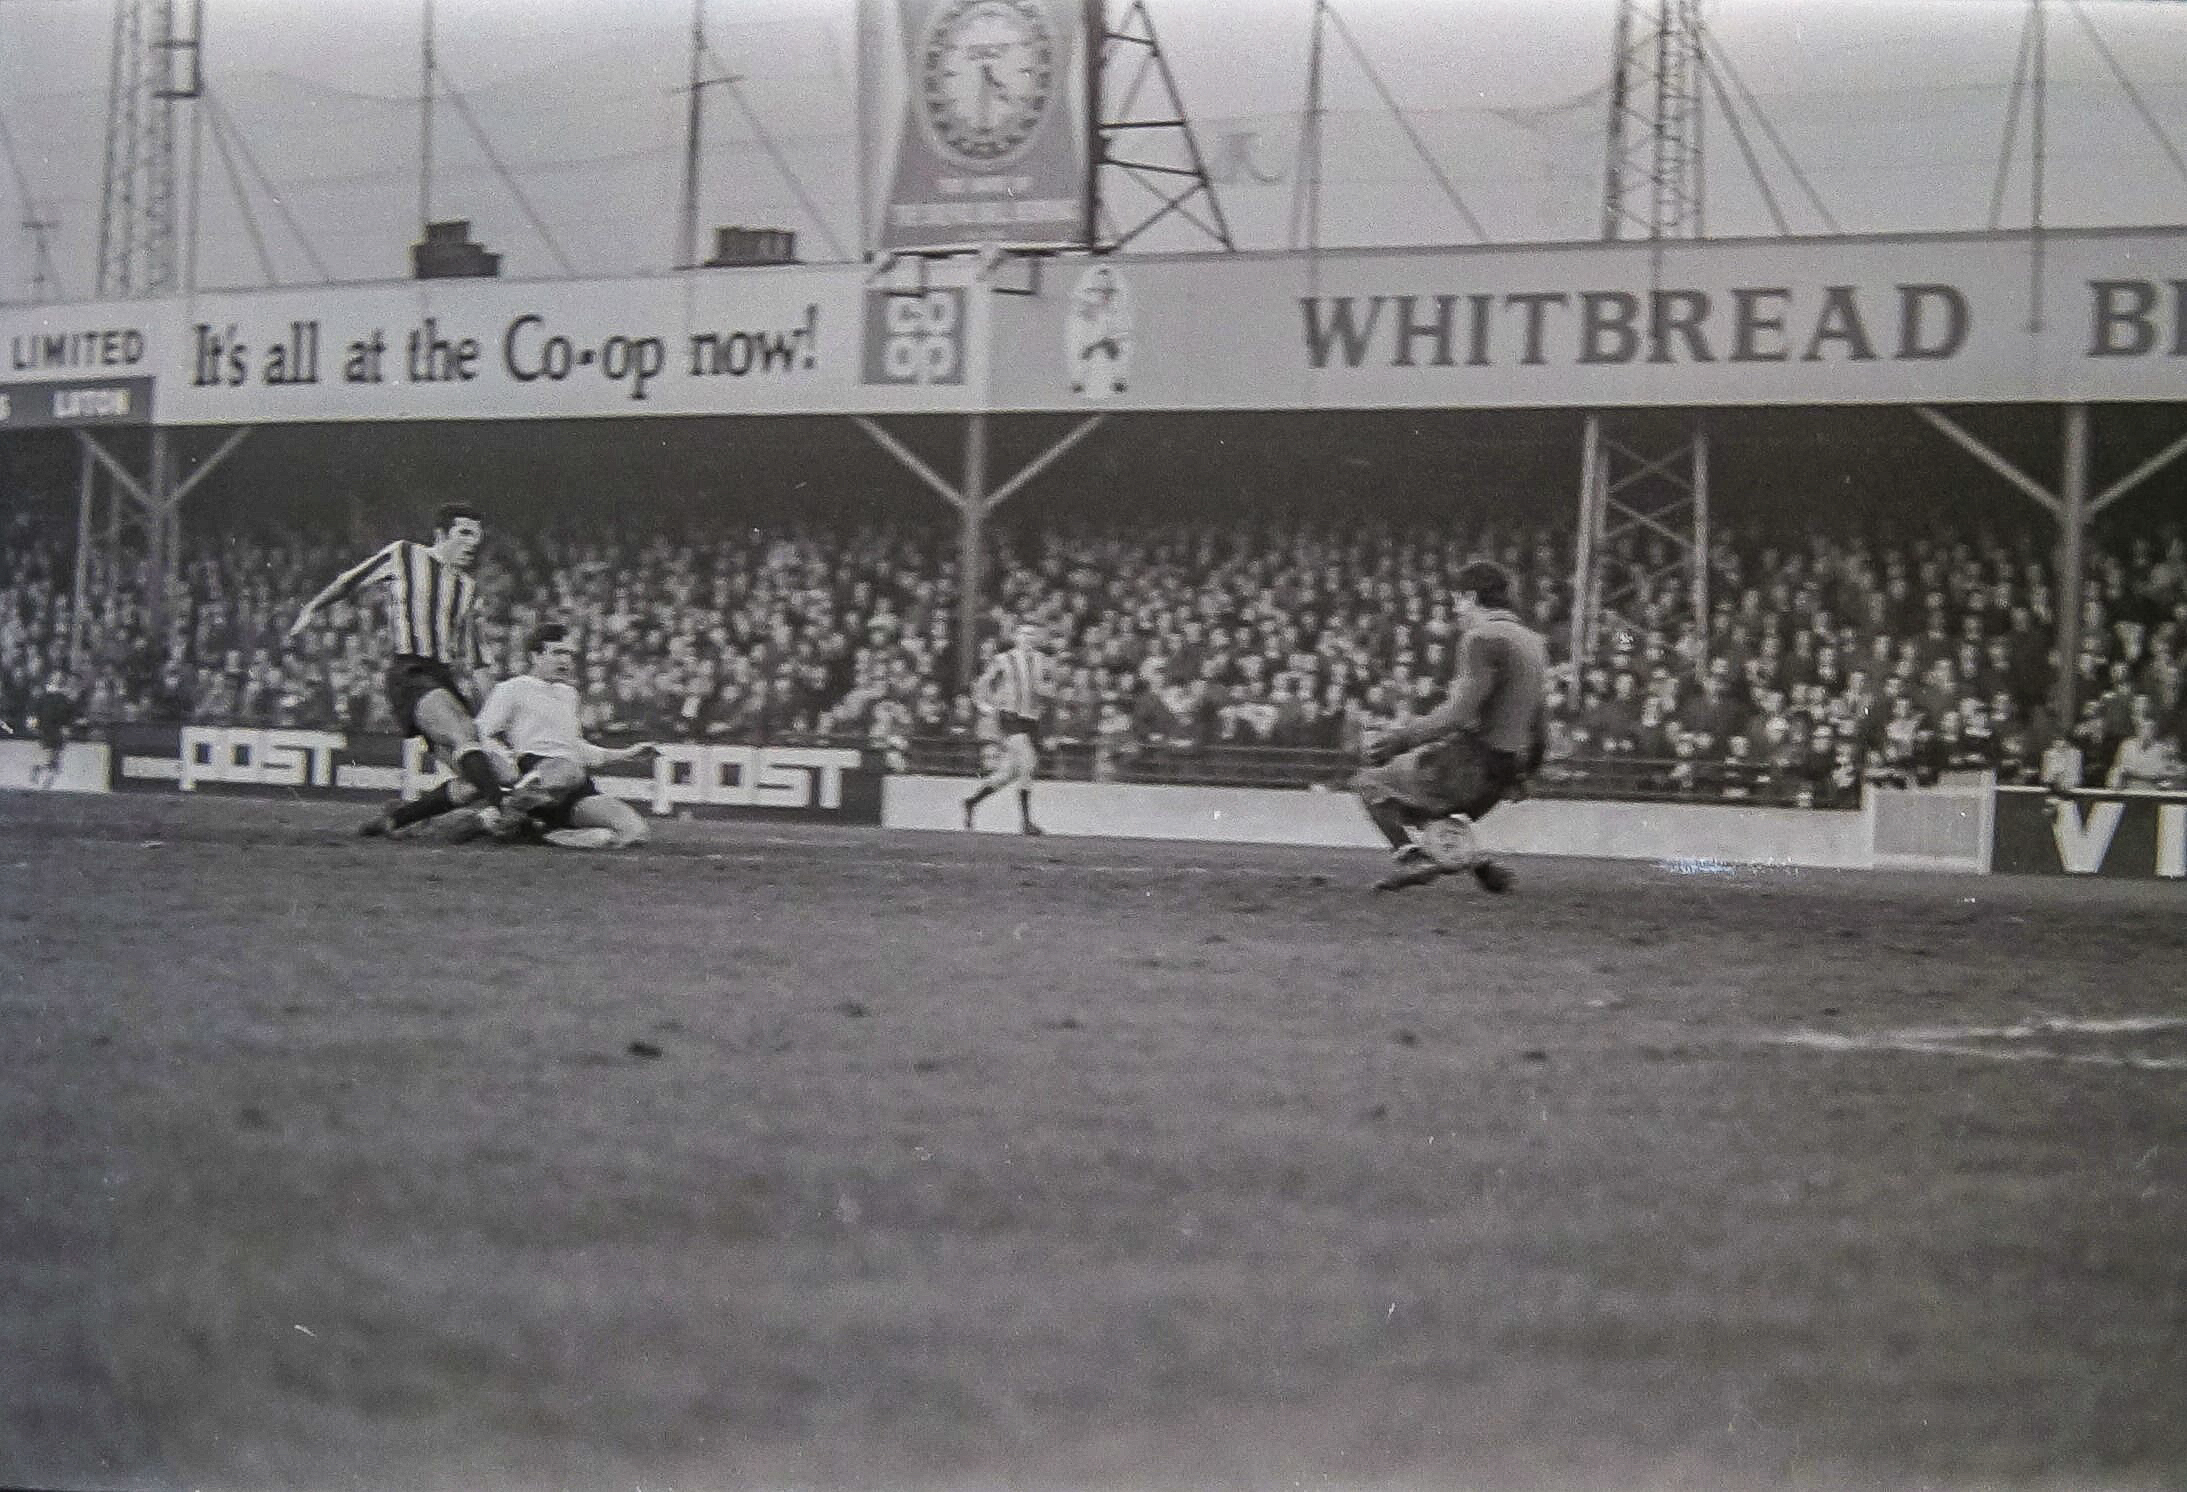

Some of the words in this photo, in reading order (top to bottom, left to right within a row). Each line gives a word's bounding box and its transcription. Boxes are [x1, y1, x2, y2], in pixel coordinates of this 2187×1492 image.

[12, 329, 145, 370] LIMITED
[193, 322, 247, 386] It's
[264, 320, 320, 386] all
[345, 327, 385, 384] at
[408, 317, 478, 382] the
[688, 303, 819, 377] now!
[1300, 284, 1972, 368] WHITBREAD
